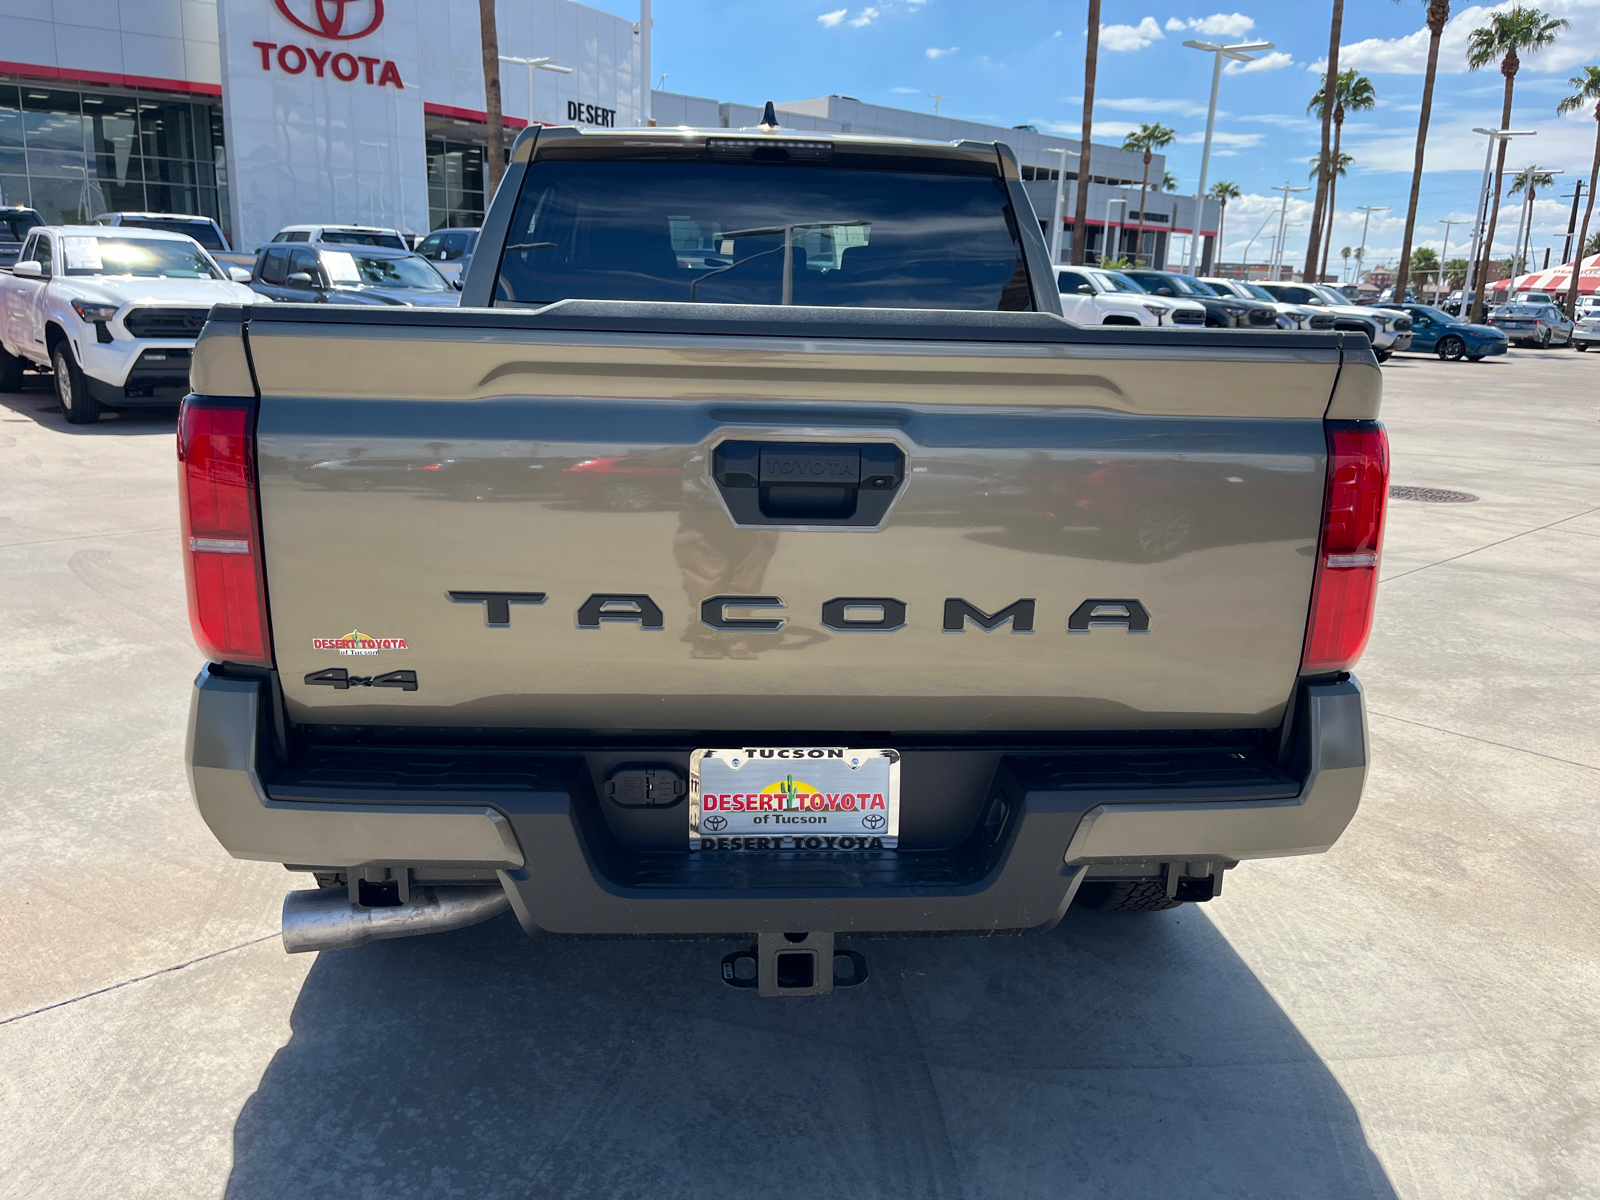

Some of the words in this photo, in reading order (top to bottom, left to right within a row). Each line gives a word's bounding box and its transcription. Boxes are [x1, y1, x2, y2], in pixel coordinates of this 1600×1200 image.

[252, 40, 404, 90] TOYOTA
[567, 100, 616, 128] DESERT
[765, 458, 854, 476] TOYOTA
[446, 590, 1151, 633] TACOMA
[313, 639, 357, 649] DESERT
[360, 639, 407, 649] TOYOTA
[304, 667, 418, 691] 4x4
[745, 749, 844, 759] TUCSON
[703, 793, 788, 811] DESERT
[798, 793, 886, 811] TOYOTA
[753, 814, 770, 824] of
[772, 814, 827, 824] Tucson
[701, 836, 784, 851] DESERT
[794, 836, 884, 850] TOYOTA
